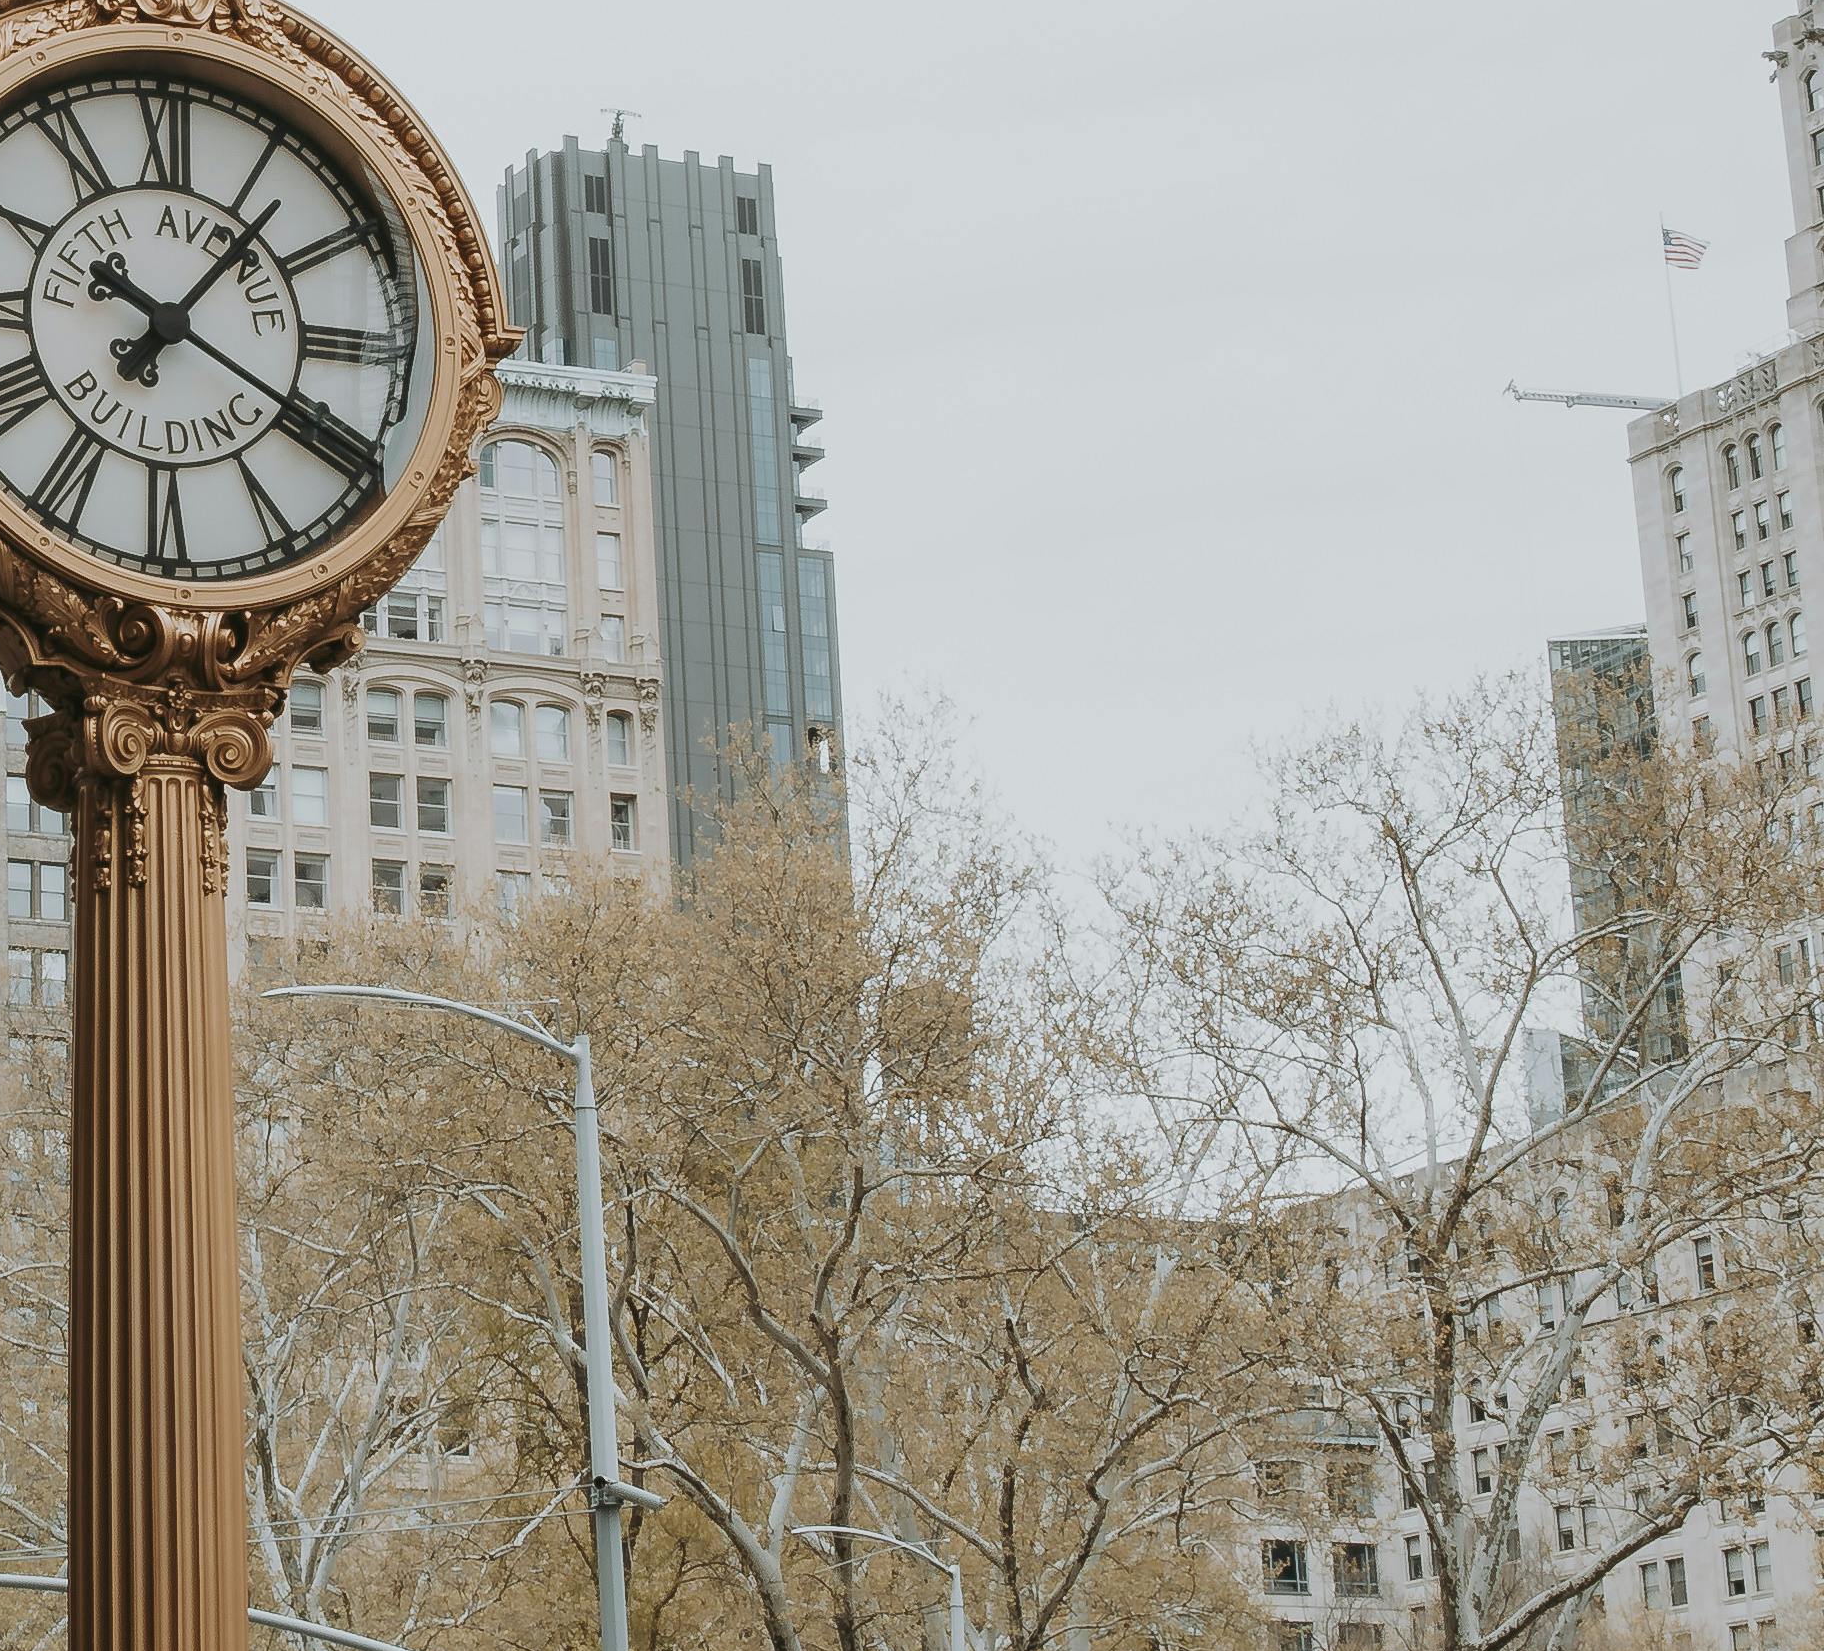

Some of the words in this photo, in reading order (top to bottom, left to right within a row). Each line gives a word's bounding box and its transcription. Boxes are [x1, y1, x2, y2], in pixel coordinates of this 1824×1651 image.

[31, 102, 117, 207] XI
[135, 93, 194, 192] XII
[231, 137, 280, 216] I
[42, 208, 133, 309] FIFTH
[278, 222, 368, 280] II
[301, 322, 392, 365] III
[63, 369, 264, 455] BUILDING
[26, 428, 109, 532] VII
[145, 462, 191, 563] VI
[232, 451, 297, 548] V
